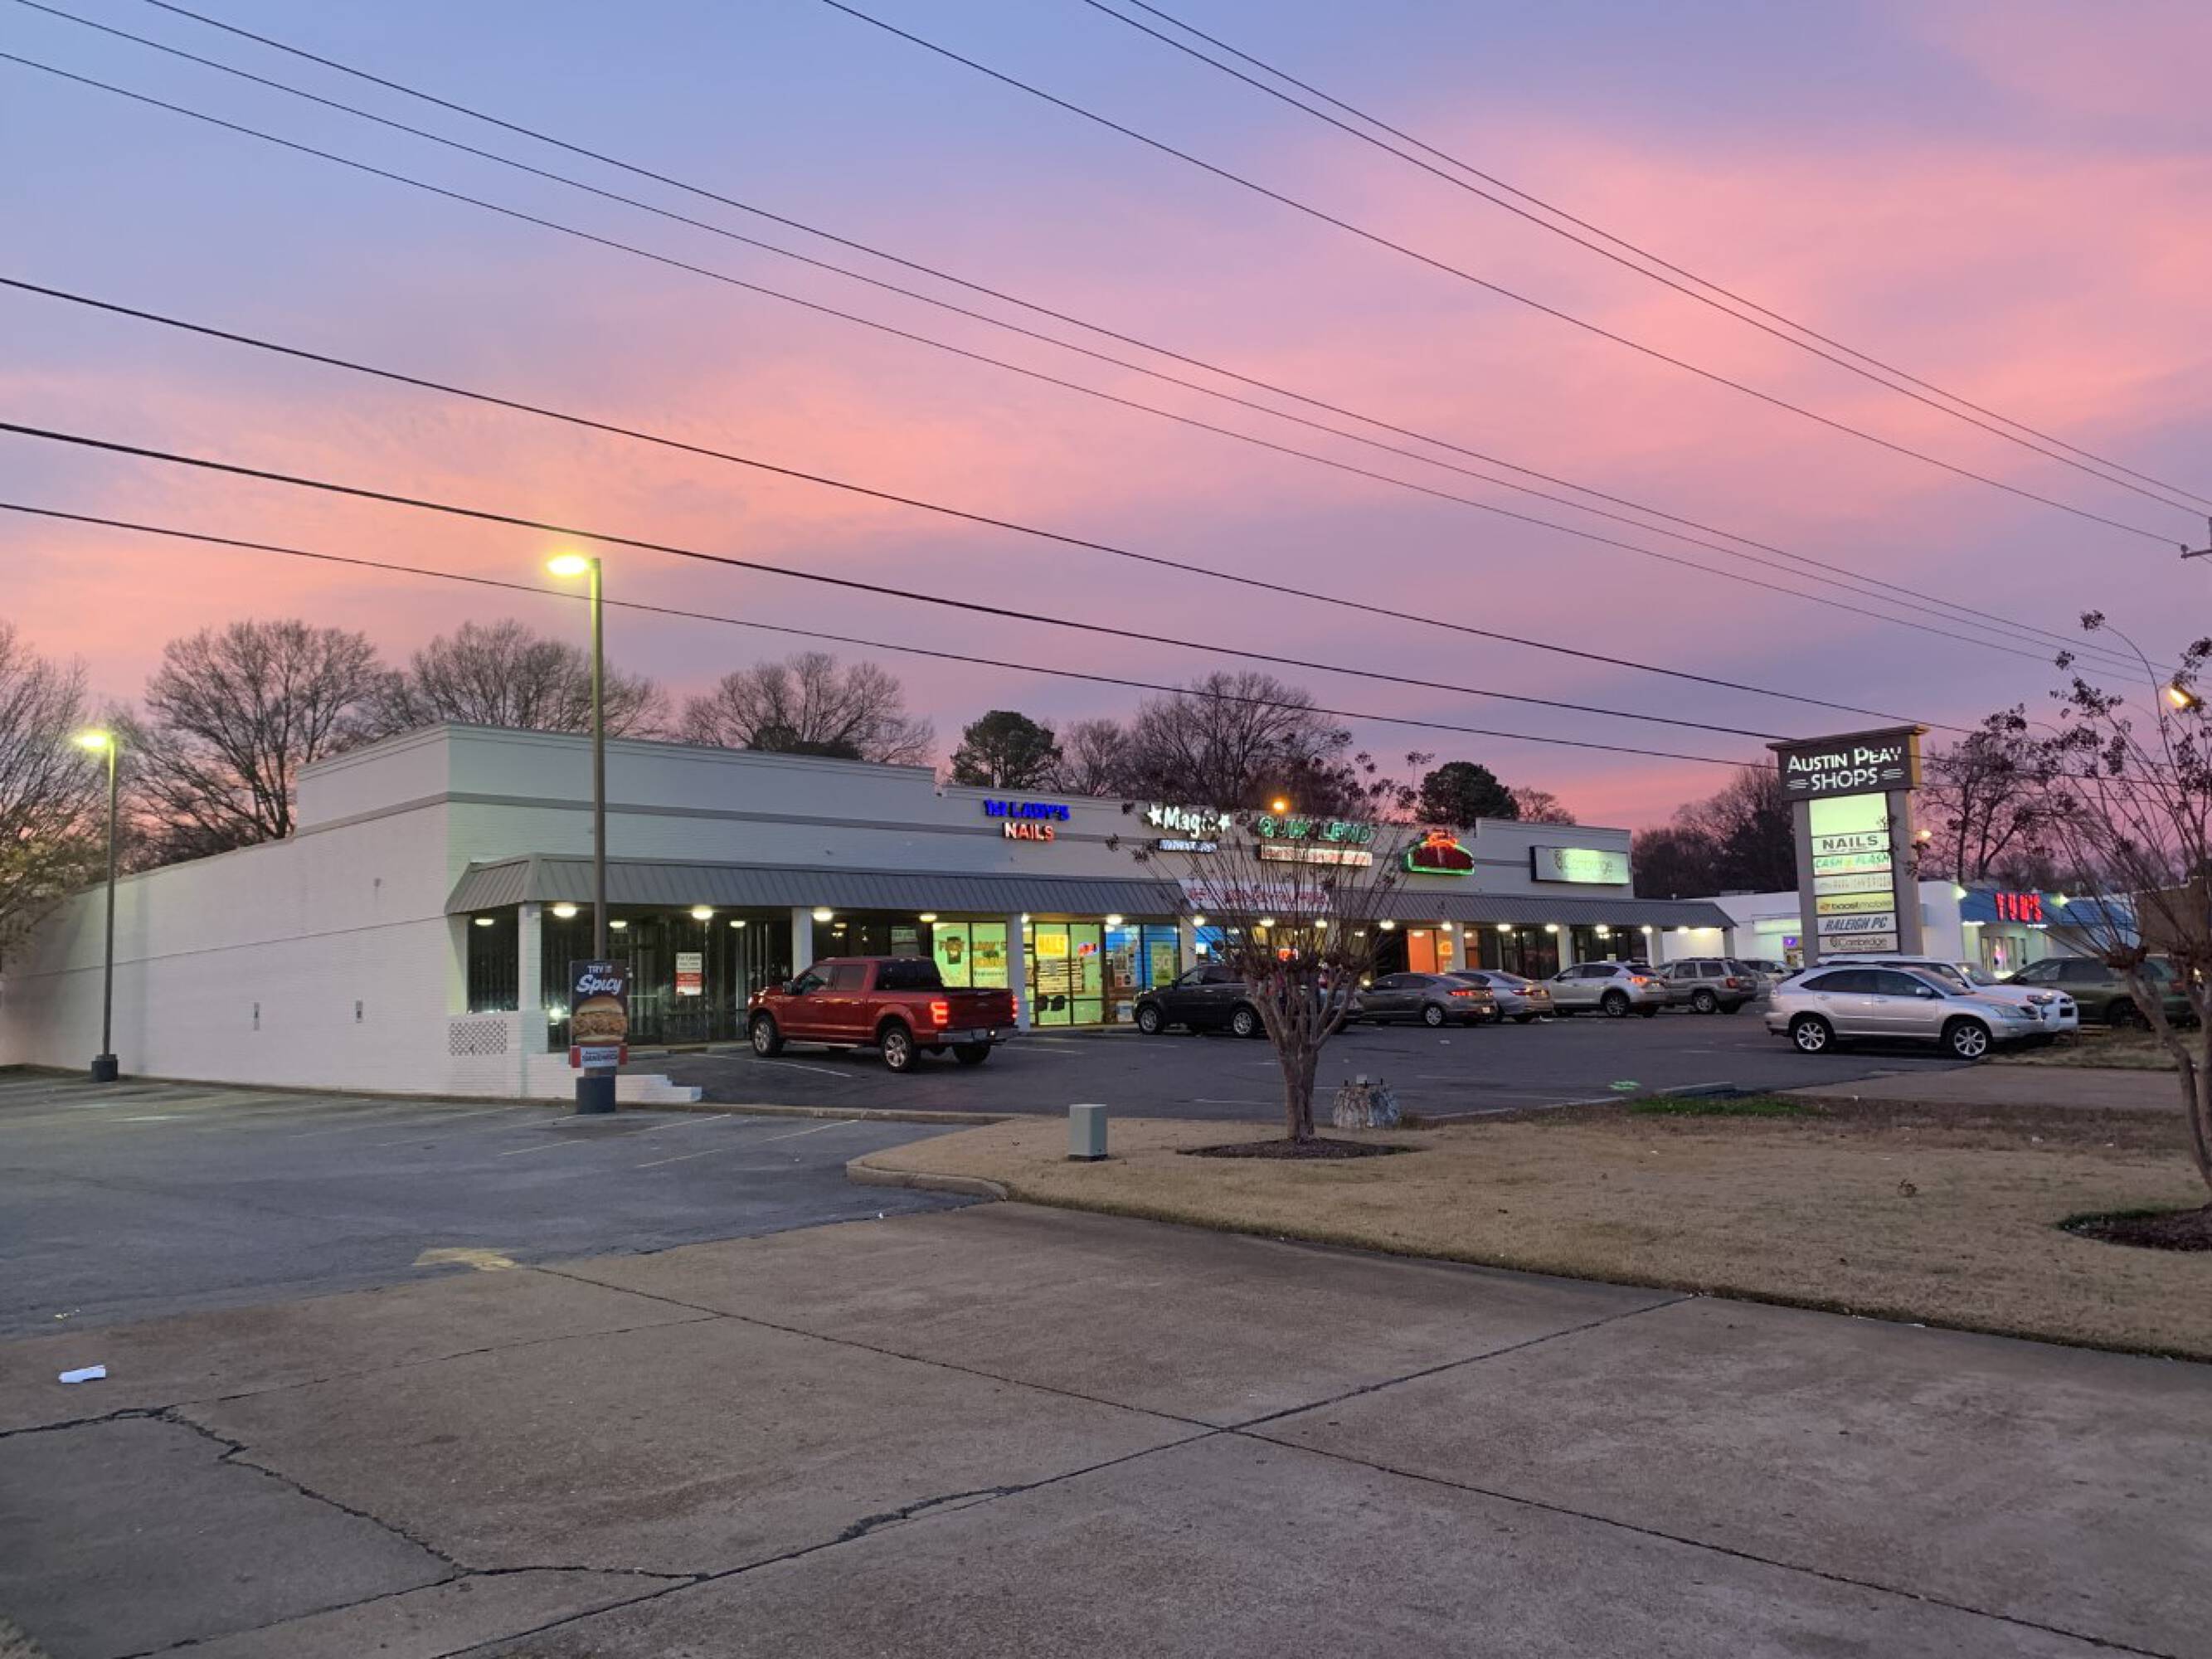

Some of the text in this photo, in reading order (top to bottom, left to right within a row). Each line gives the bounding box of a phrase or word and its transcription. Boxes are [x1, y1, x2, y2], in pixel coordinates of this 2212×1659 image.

[1787, 746, 1902, 772] AUSTIN PEAY
[1810, 767, 1879, 791] SHOPS
[1004, 822, 1055, 842] NAILS
[1821, 834, 1879, 849] NAILS
[1824, 915, 1889, 932] RALEIGH PC
[587, 966, 604, 974] TRY
[576, 974, 623, 996] Spicy
